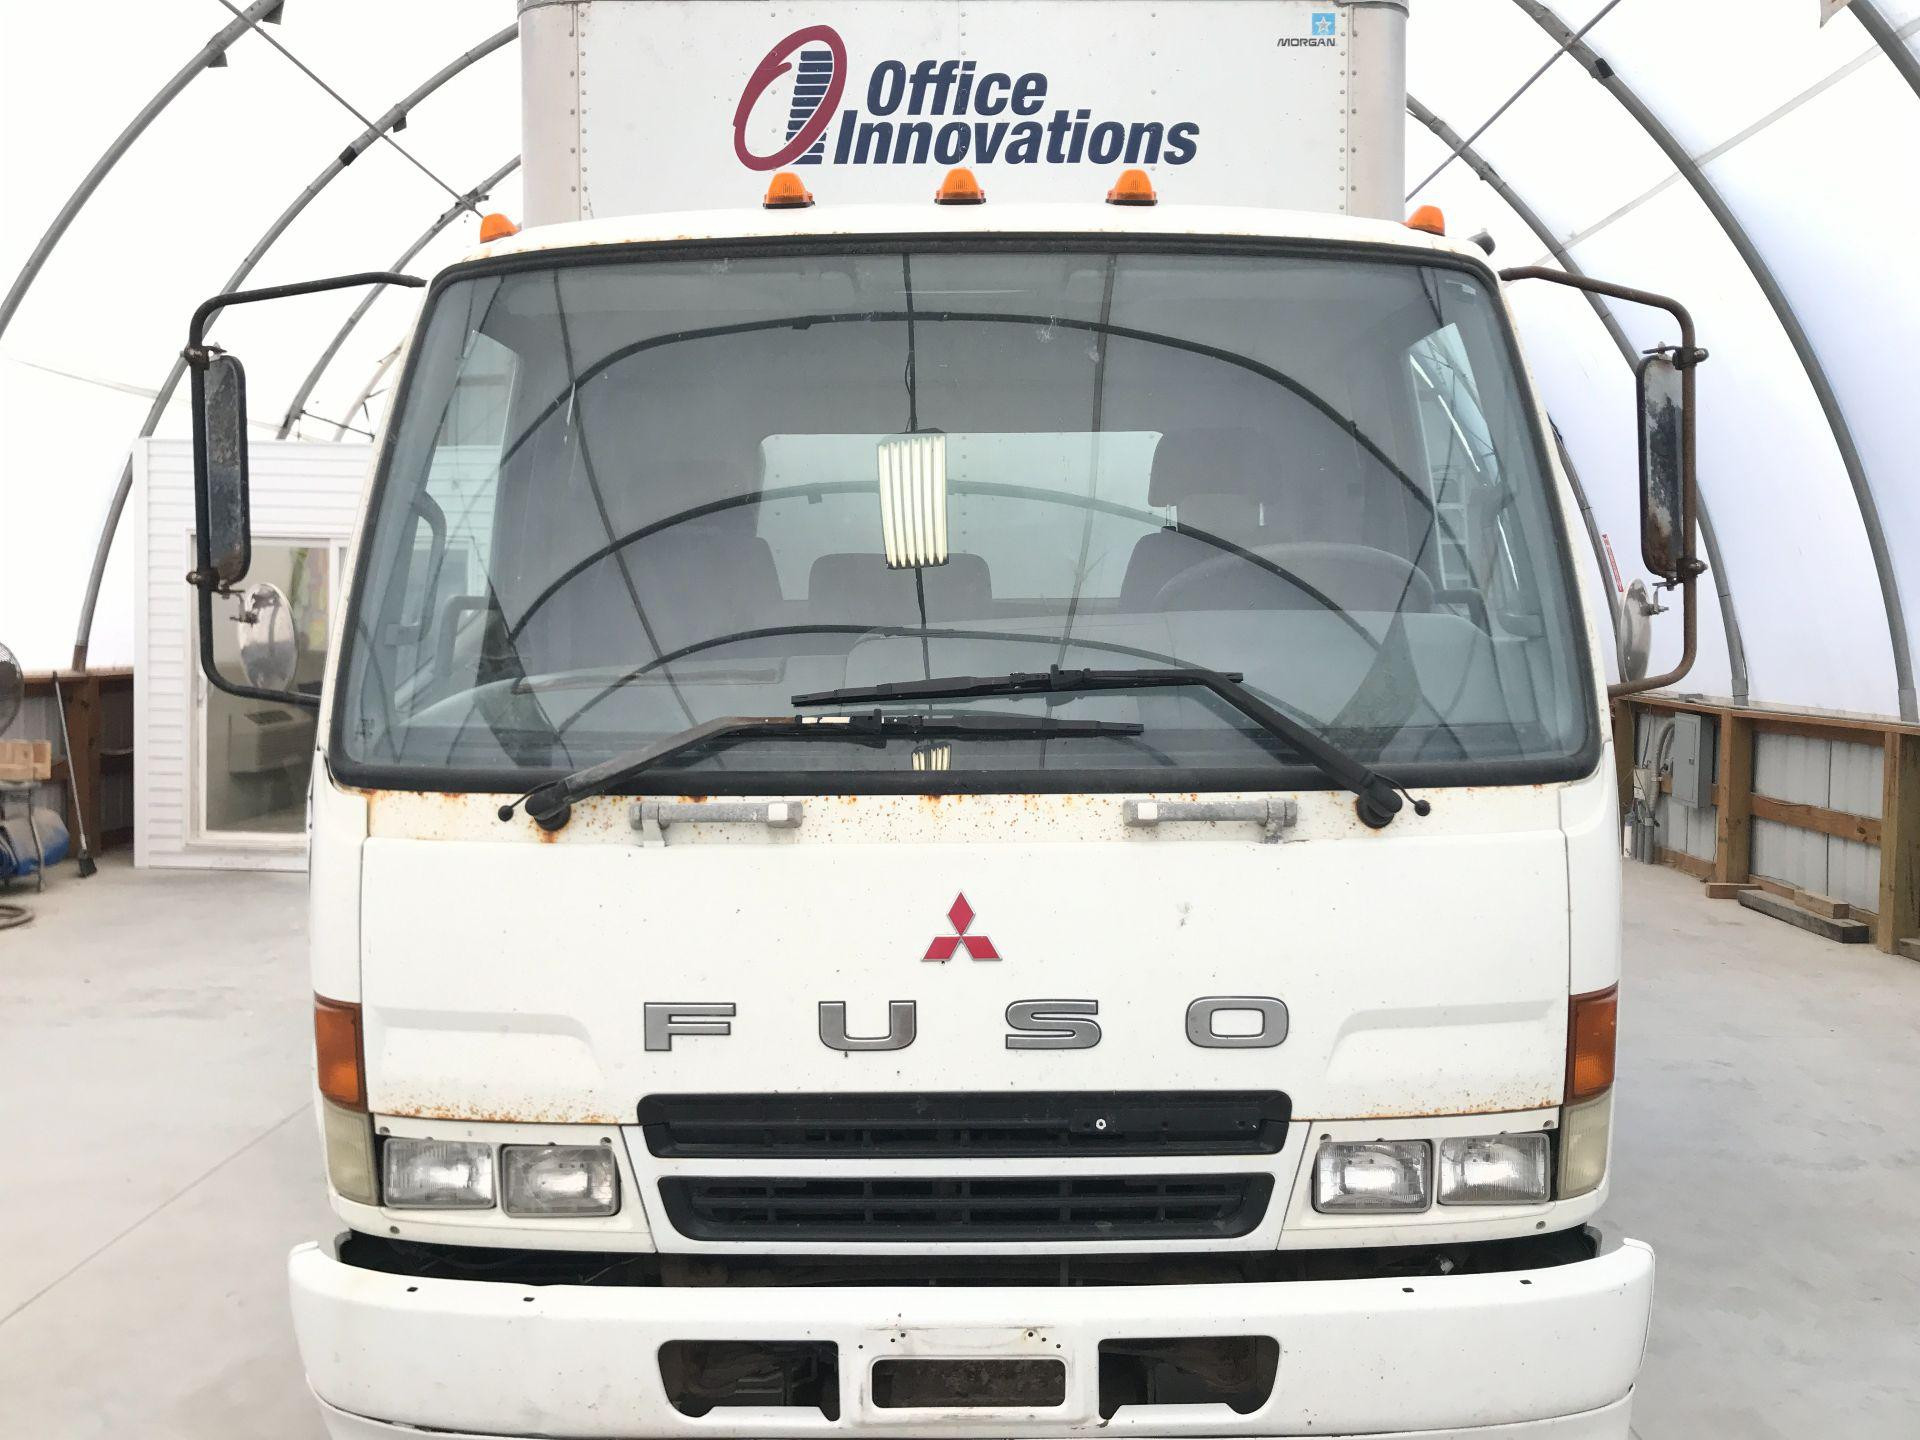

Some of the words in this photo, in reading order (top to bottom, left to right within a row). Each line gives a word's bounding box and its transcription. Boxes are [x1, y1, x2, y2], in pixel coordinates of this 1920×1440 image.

[1277, 37, 1336, 47] MORGAN
[866, 59, 1048, 117] Office
[833, 109, 1200, 165] Innovations
[643, 996, 1290, 1052] FUSO
